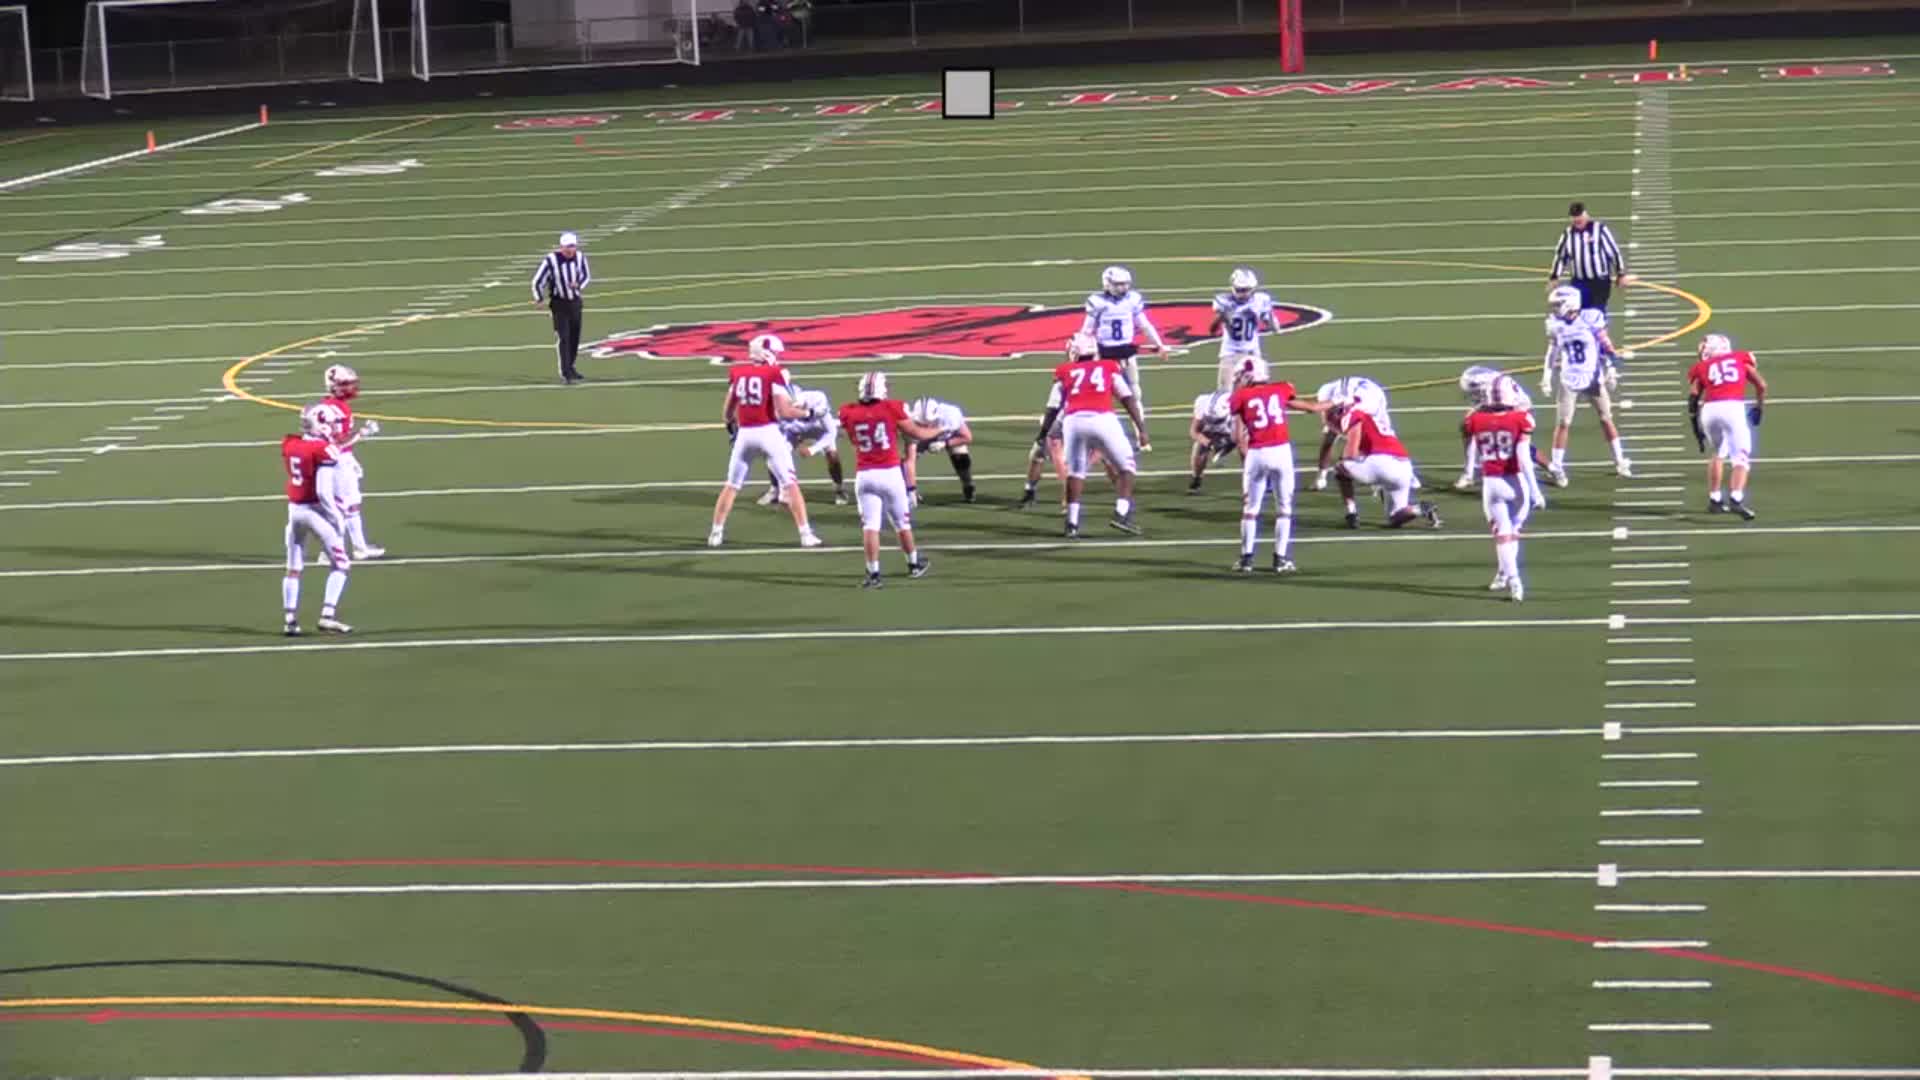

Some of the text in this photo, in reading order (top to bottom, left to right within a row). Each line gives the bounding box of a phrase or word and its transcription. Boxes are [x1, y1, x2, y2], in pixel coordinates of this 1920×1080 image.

[1111, 319, 1123, 341] 8
[1231, 314, 1254, 341] 20
[1563, 339, 1586, 365] 18
[1069, 366, 1105, 395] 74
[1708, 358, 1739, 386] 45
[735, 376, 762, 405] 49
[1247, 394, 1284, 428] 34
[854, 422, 890, 452] 54
[1479, 431, 1513, 461] 28
[289, 456, 303, 486] 5
